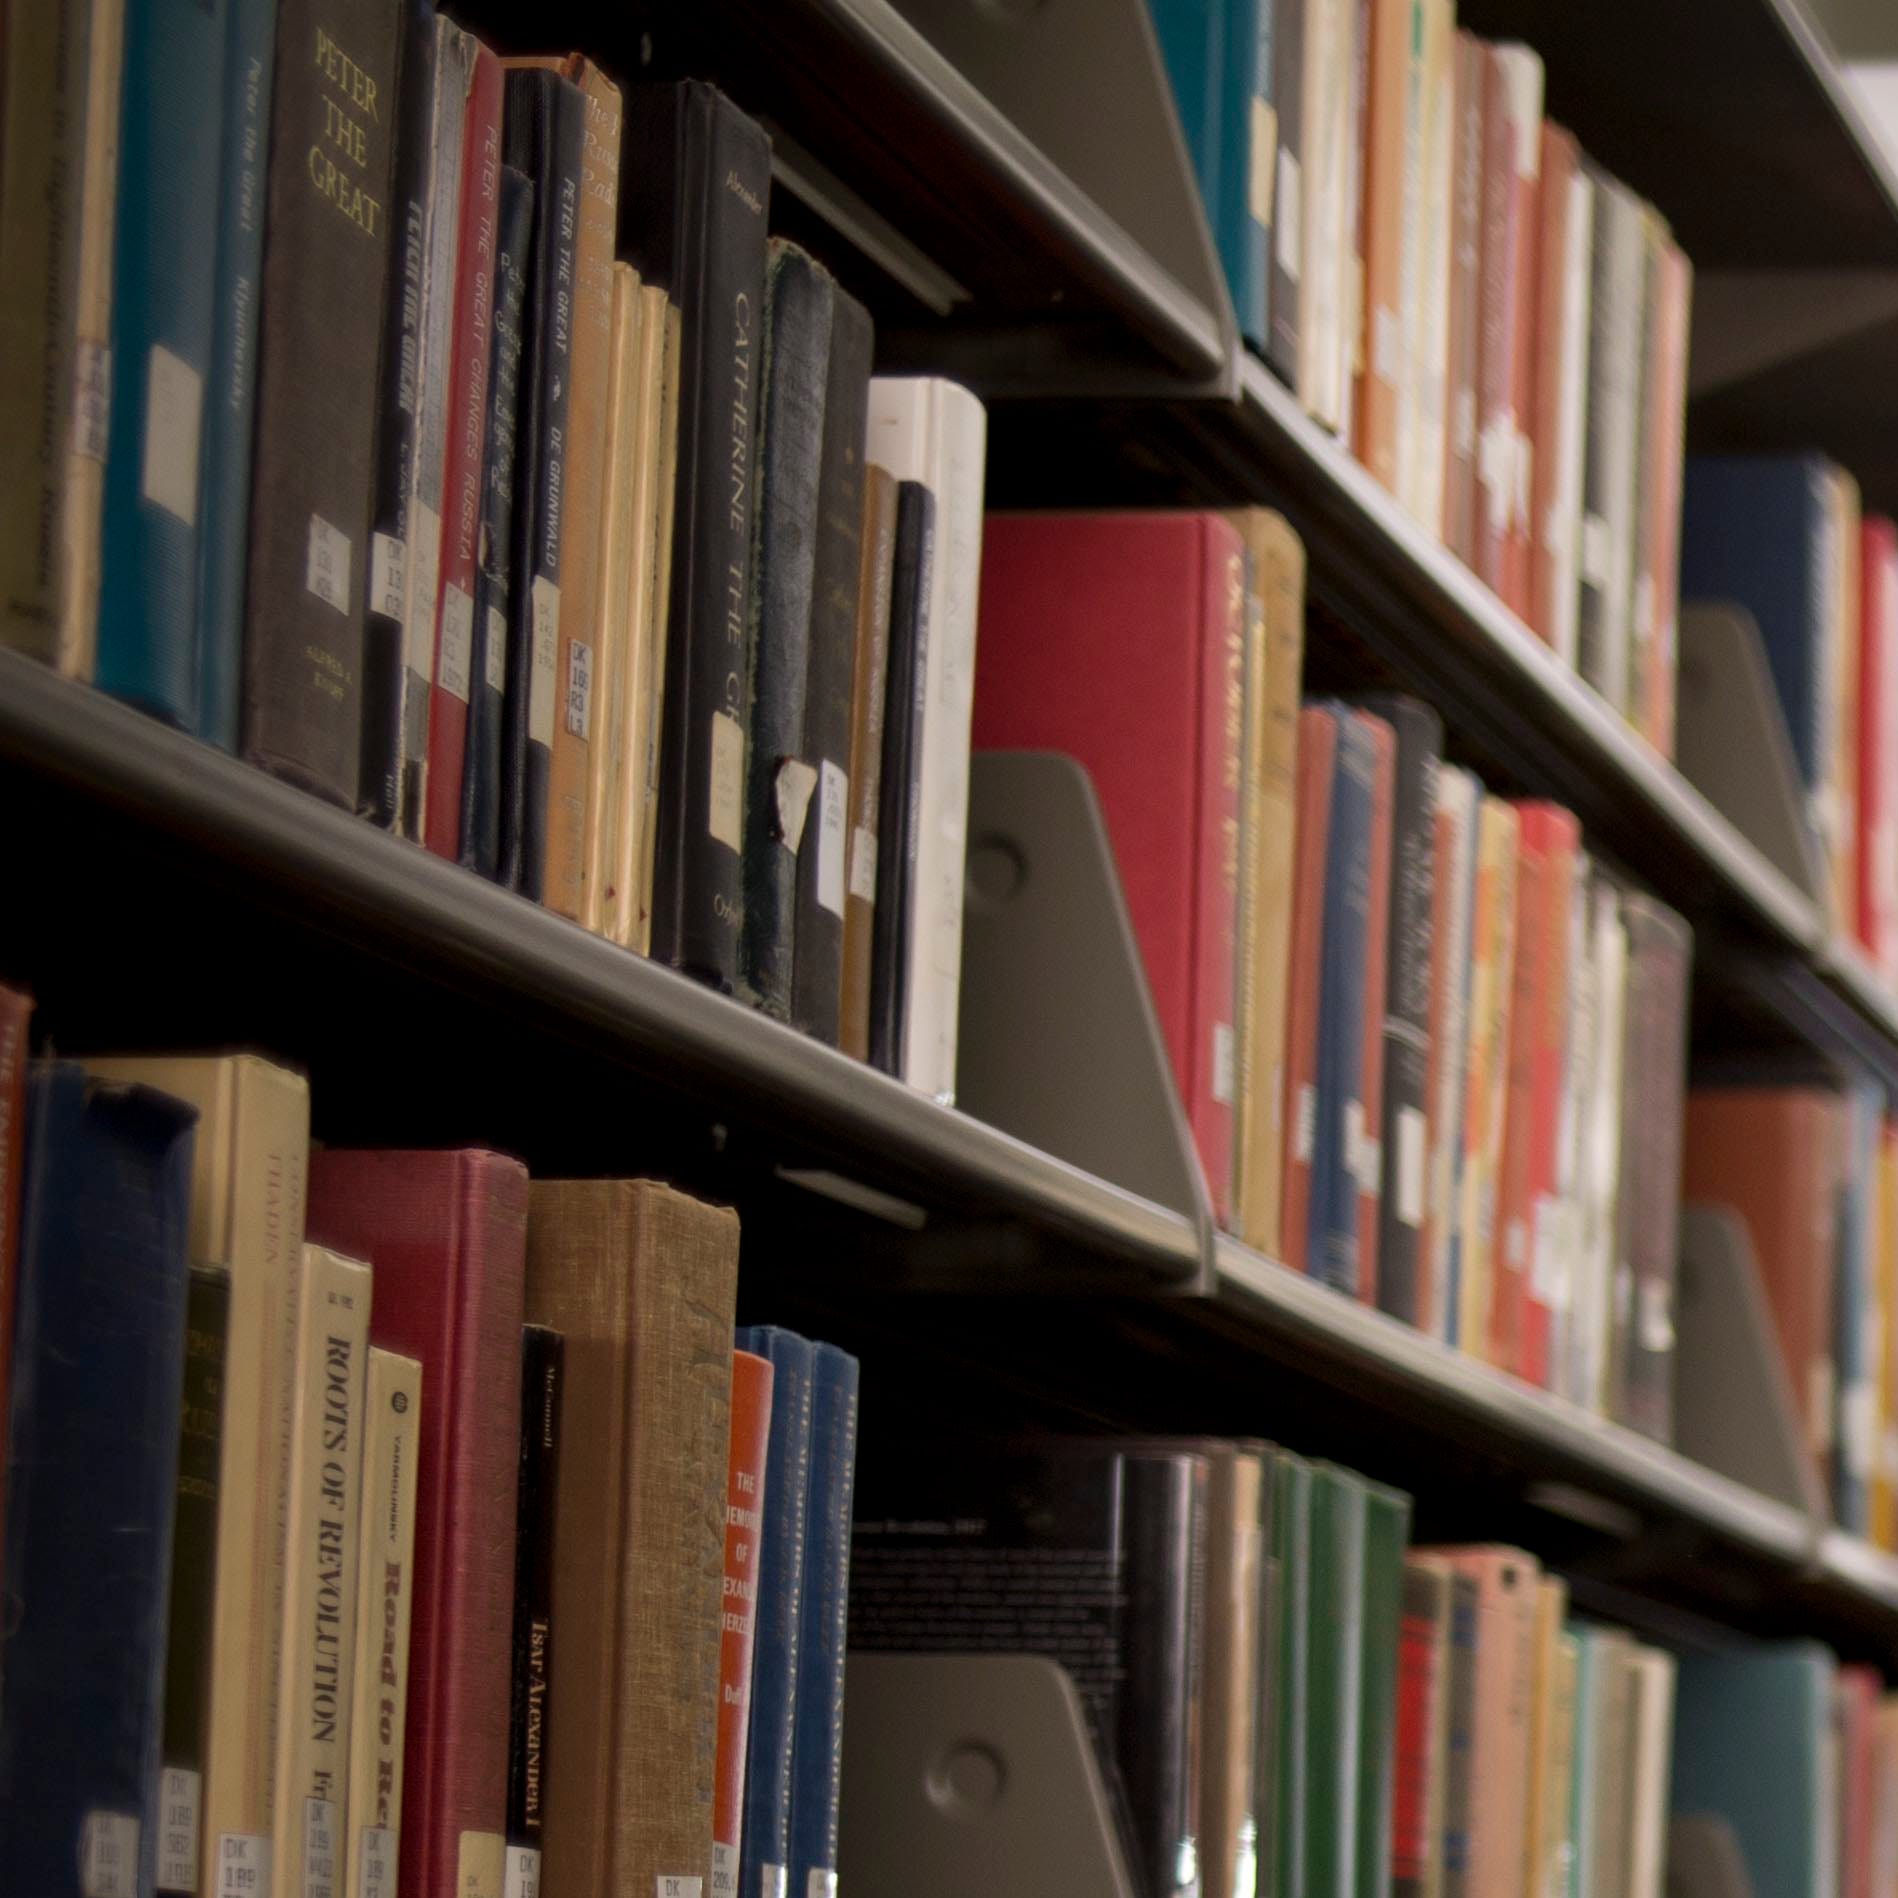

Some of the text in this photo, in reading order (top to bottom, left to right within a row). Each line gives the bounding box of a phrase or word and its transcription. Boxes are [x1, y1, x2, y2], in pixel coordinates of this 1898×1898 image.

[315, 27, 379, 122] PETER
[239, 57, 263, 232] Peter the Great
[323, 95, 367, 167] THE
[308, 145, 380, 237] GREAT
[553, 177, 577, 353] PETER THE GREAT
[458, 125, 499, 560] PETER THE GREAT CHANGES RUSSIA
[727, 291, 752, 533] CATHERINE
[544, 426, 563, 568] DE GRUNWALD
[725, 558, 745, 649] THE
[263, 1151, 284, 1267] THADEN
[735, 1471, 754, 1494] THE
[312, 1335, 352, 1744] ROOTS OF REVOLUTION
[735, 1542, 749, 1563] OF
[377, 1561, 401, 1746] Road to
[530, 1620, 551, 1673] Tsar
[526, 1677, 548, 1816] Alexander
[225, 1838, 248, 1859] DK
[519, 1854, 535, 1874] DK
[666, 1878, 681, 1897] DK
